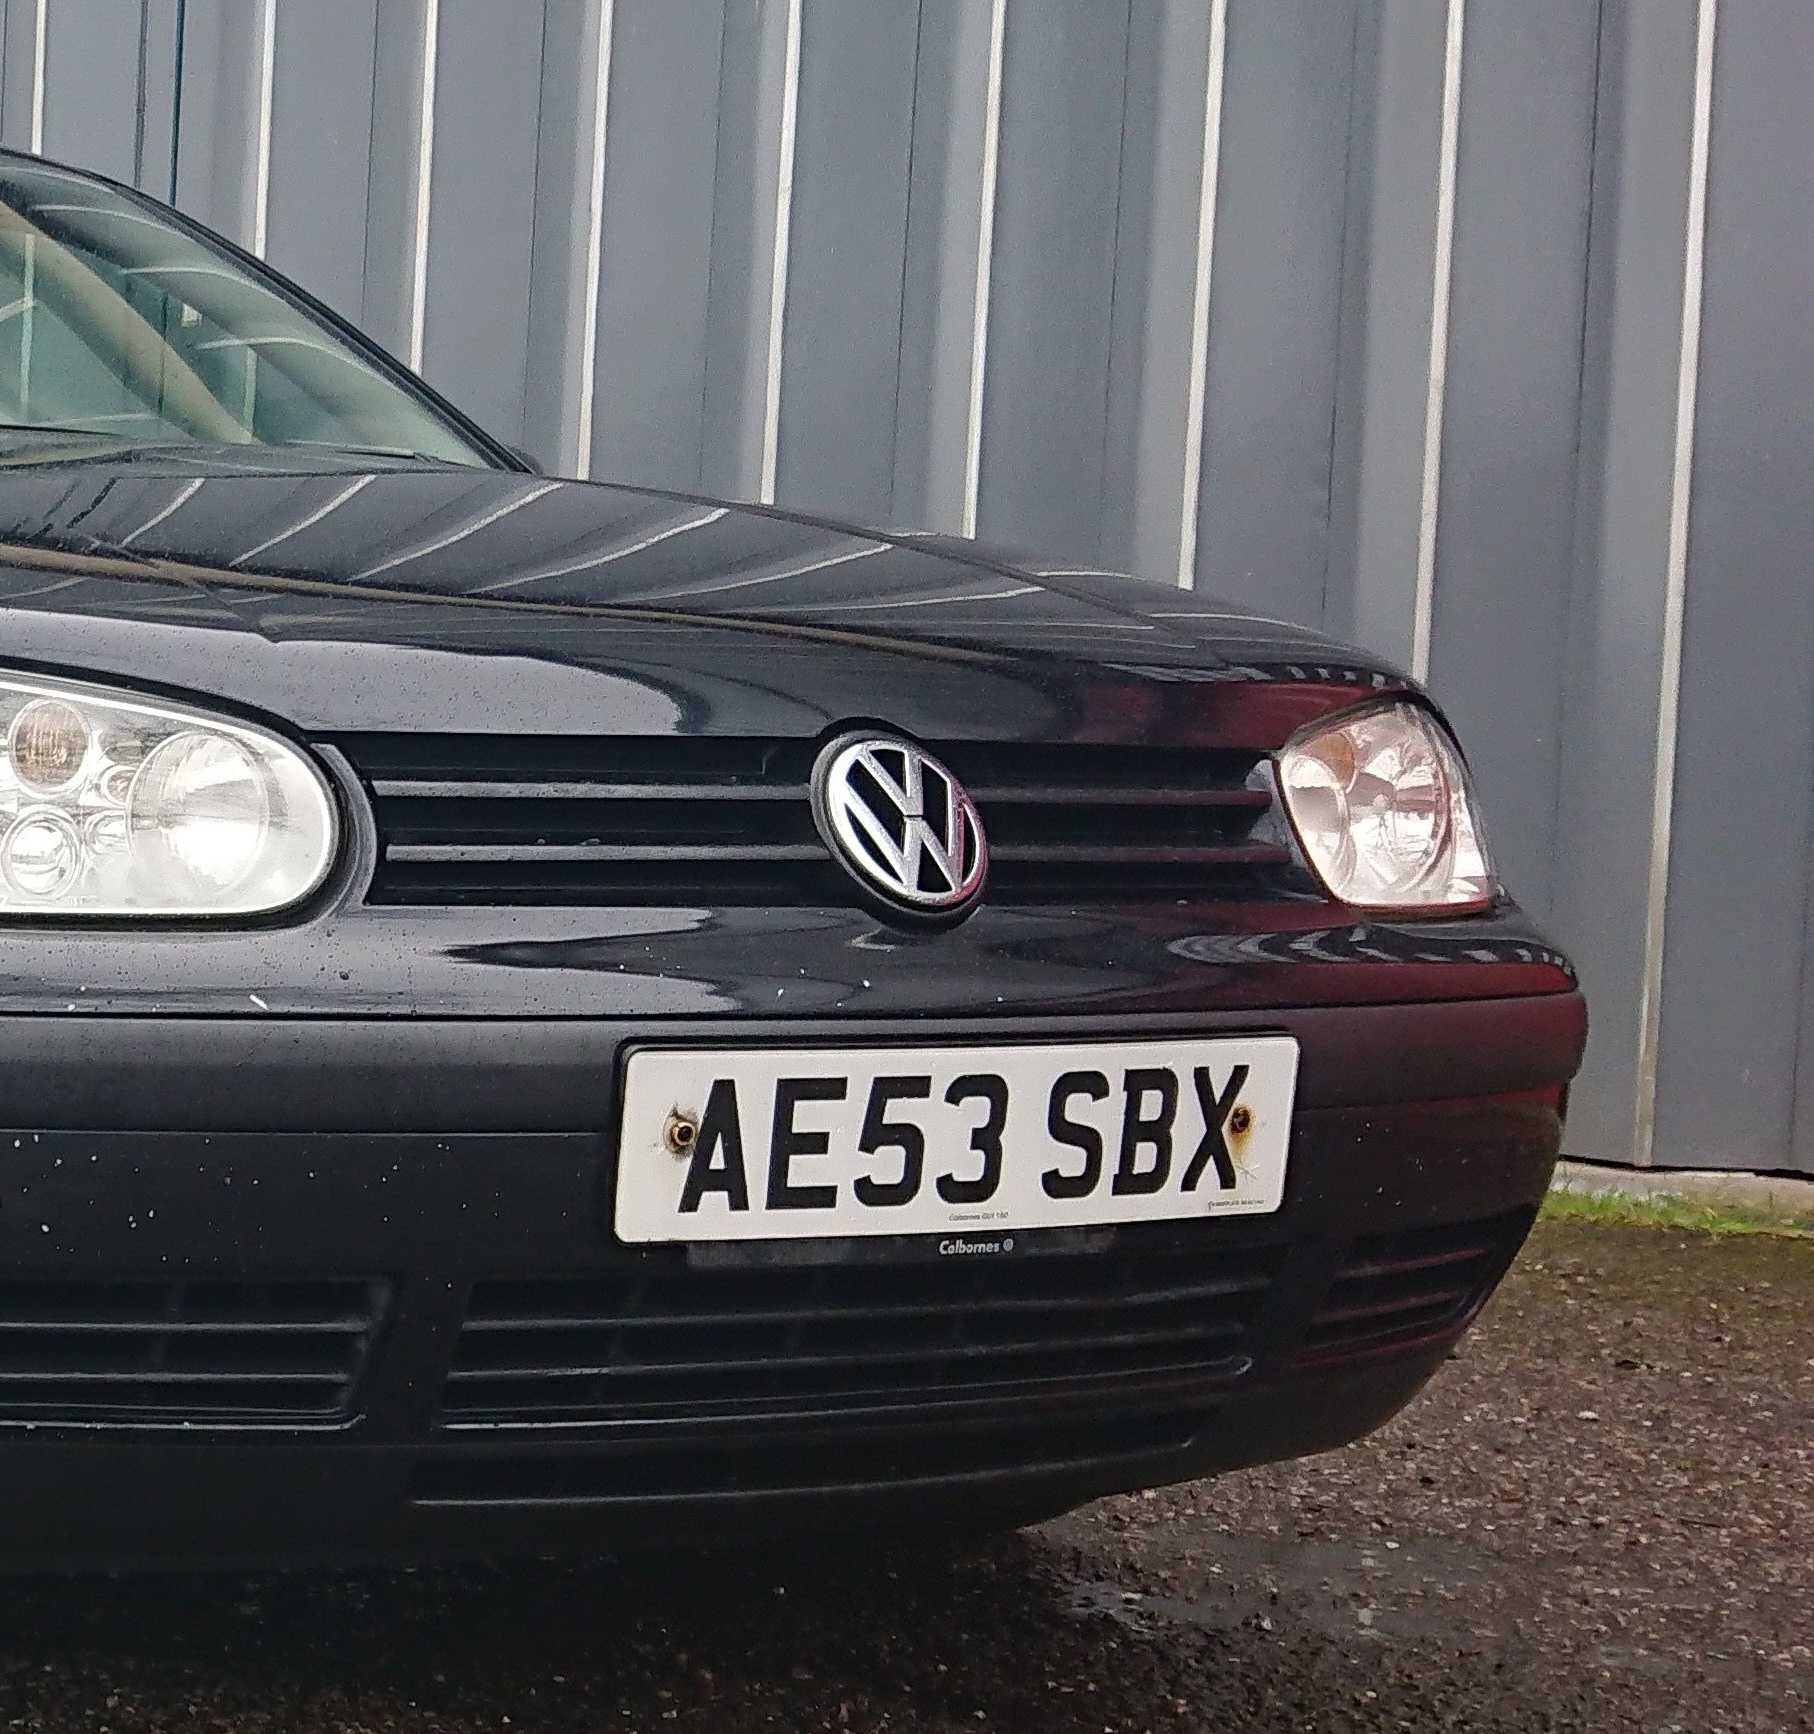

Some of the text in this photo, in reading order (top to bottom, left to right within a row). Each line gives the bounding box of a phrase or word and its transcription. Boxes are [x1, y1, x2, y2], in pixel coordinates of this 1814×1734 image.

[827, 739, 987, 906] VW
[678, 1064, 1250, 1213] AE53 SBX
